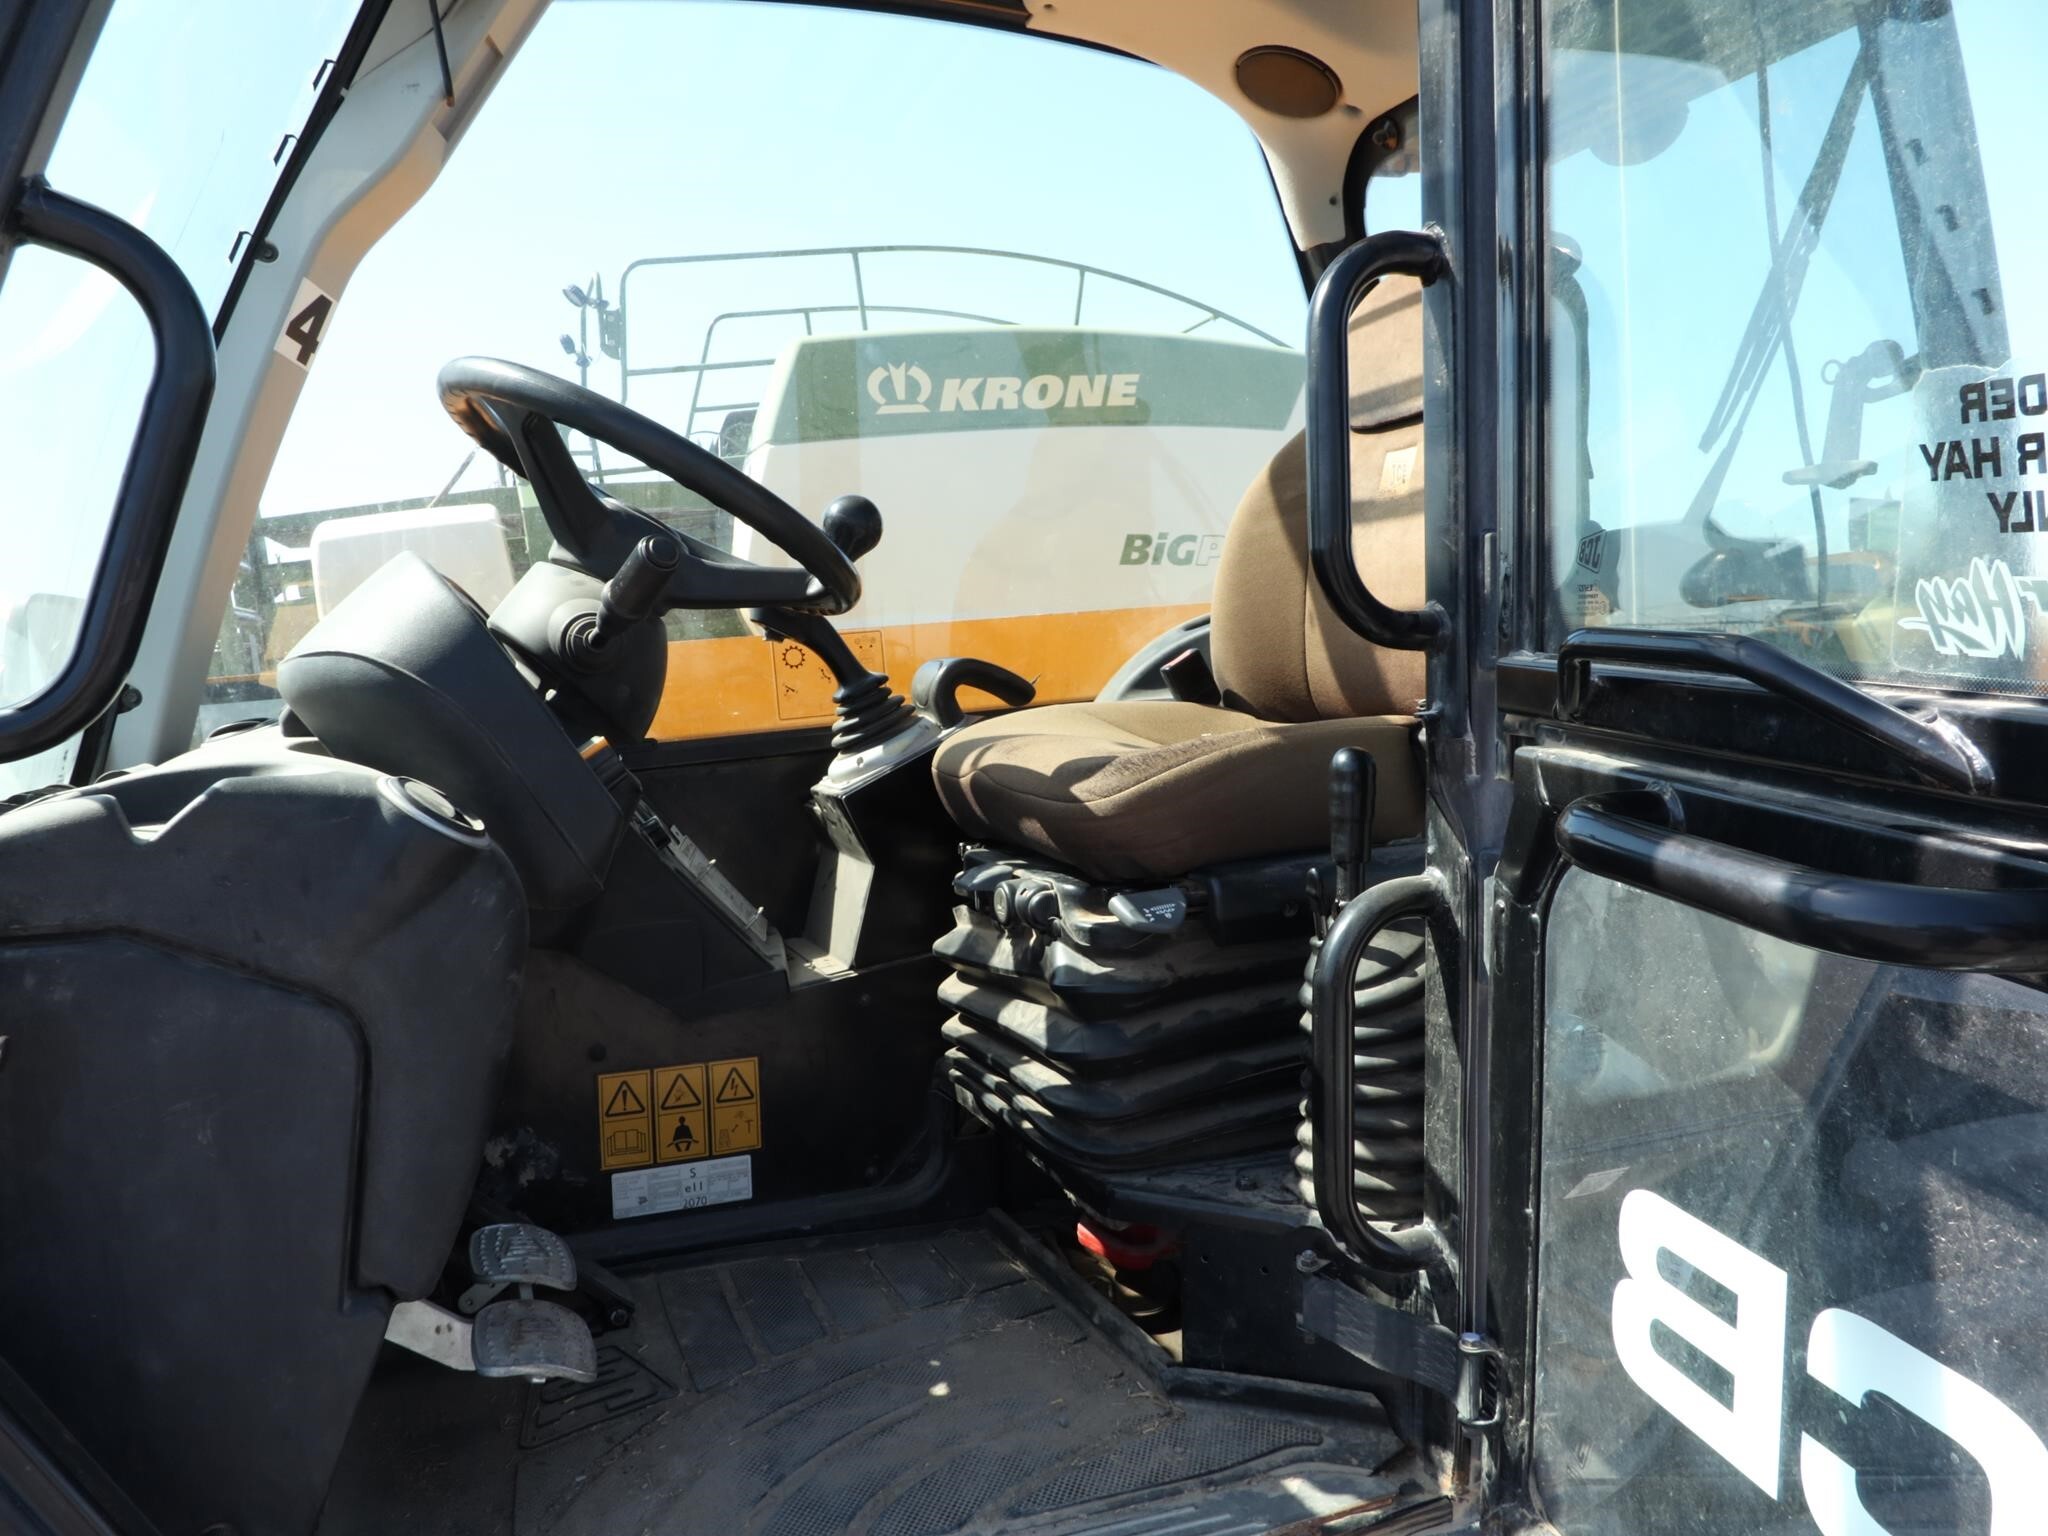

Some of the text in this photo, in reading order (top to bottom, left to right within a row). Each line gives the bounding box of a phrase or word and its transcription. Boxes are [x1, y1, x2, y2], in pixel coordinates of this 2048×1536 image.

[285, 294, 333, 366] 4
[939, 373, 1141, 412] KRONE
[682, 1196, 708, 1208] 2070
